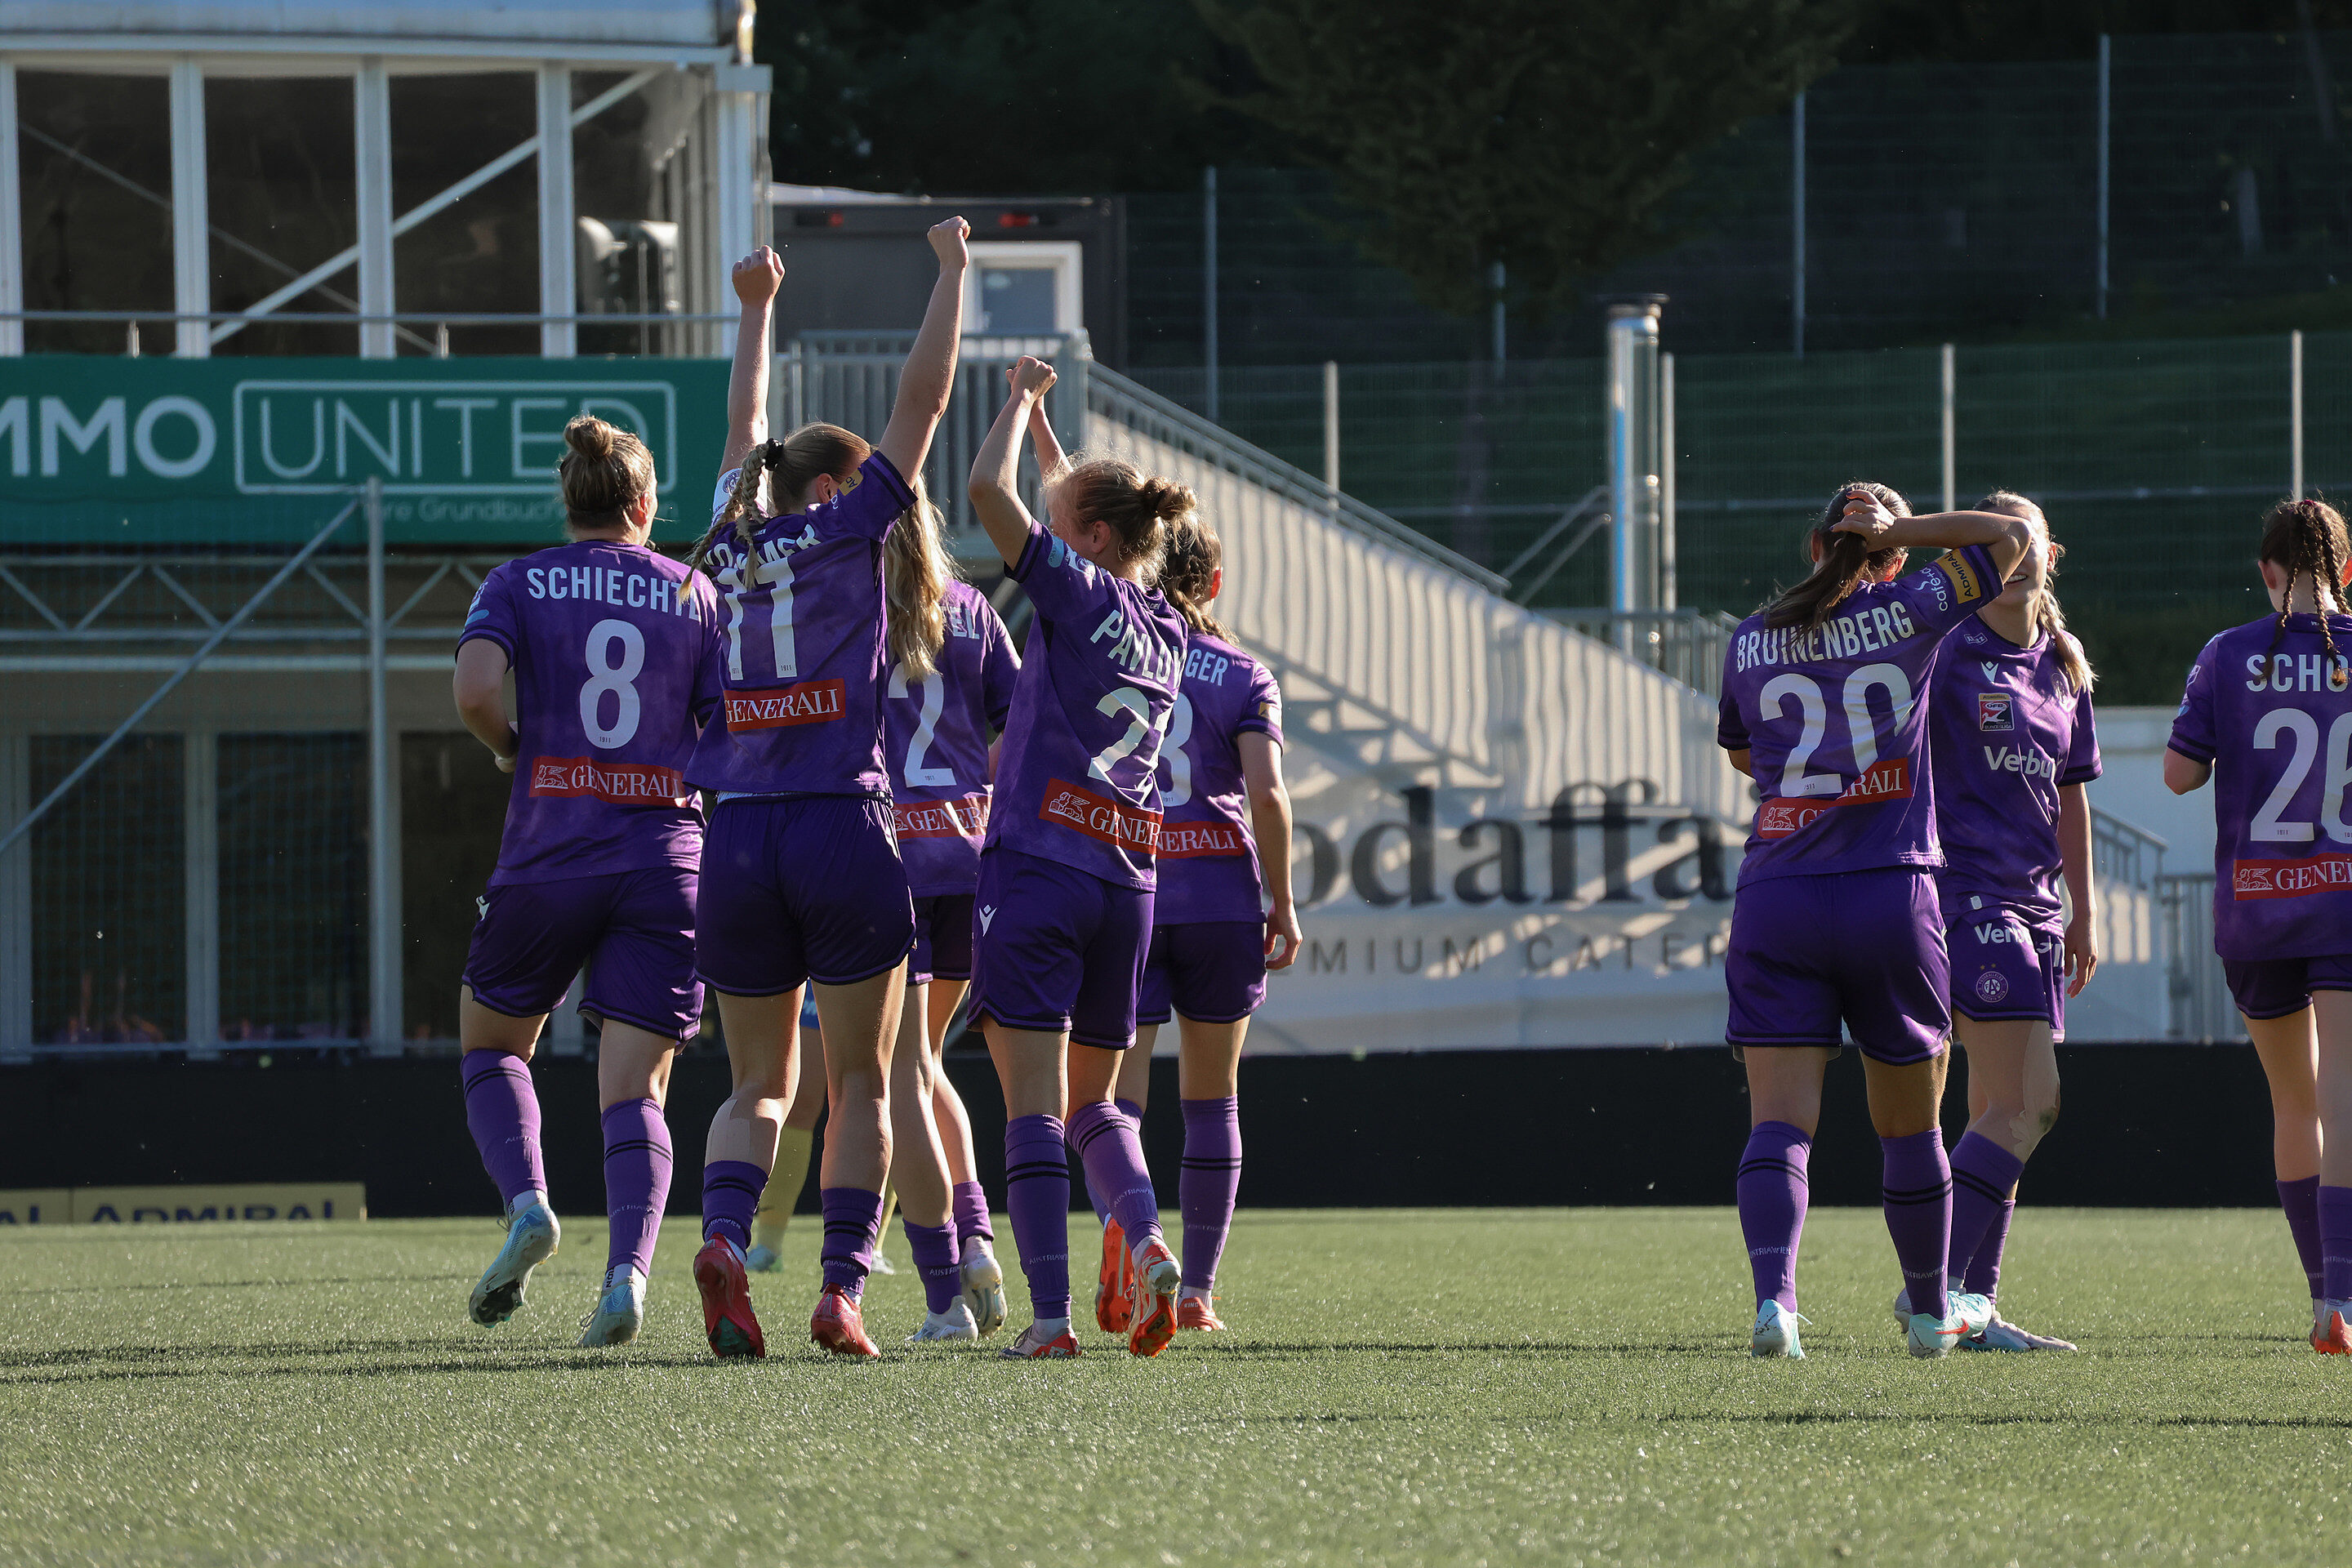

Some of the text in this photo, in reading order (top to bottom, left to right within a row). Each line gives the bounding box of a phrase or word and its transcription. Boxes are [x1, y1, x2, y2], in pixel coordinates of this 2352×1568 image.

[716, 556, 798, 681] 11
[1737, 600, 1915, 673] BRUINENBERG
[2246, 653, 2349, 693] SCHO
[579, 618, 646, 750] 8
[888, 662, 957, 788] 2
[1760, 663, 1914, 798] 20
[572, 764, 680, 799] GENERALI
